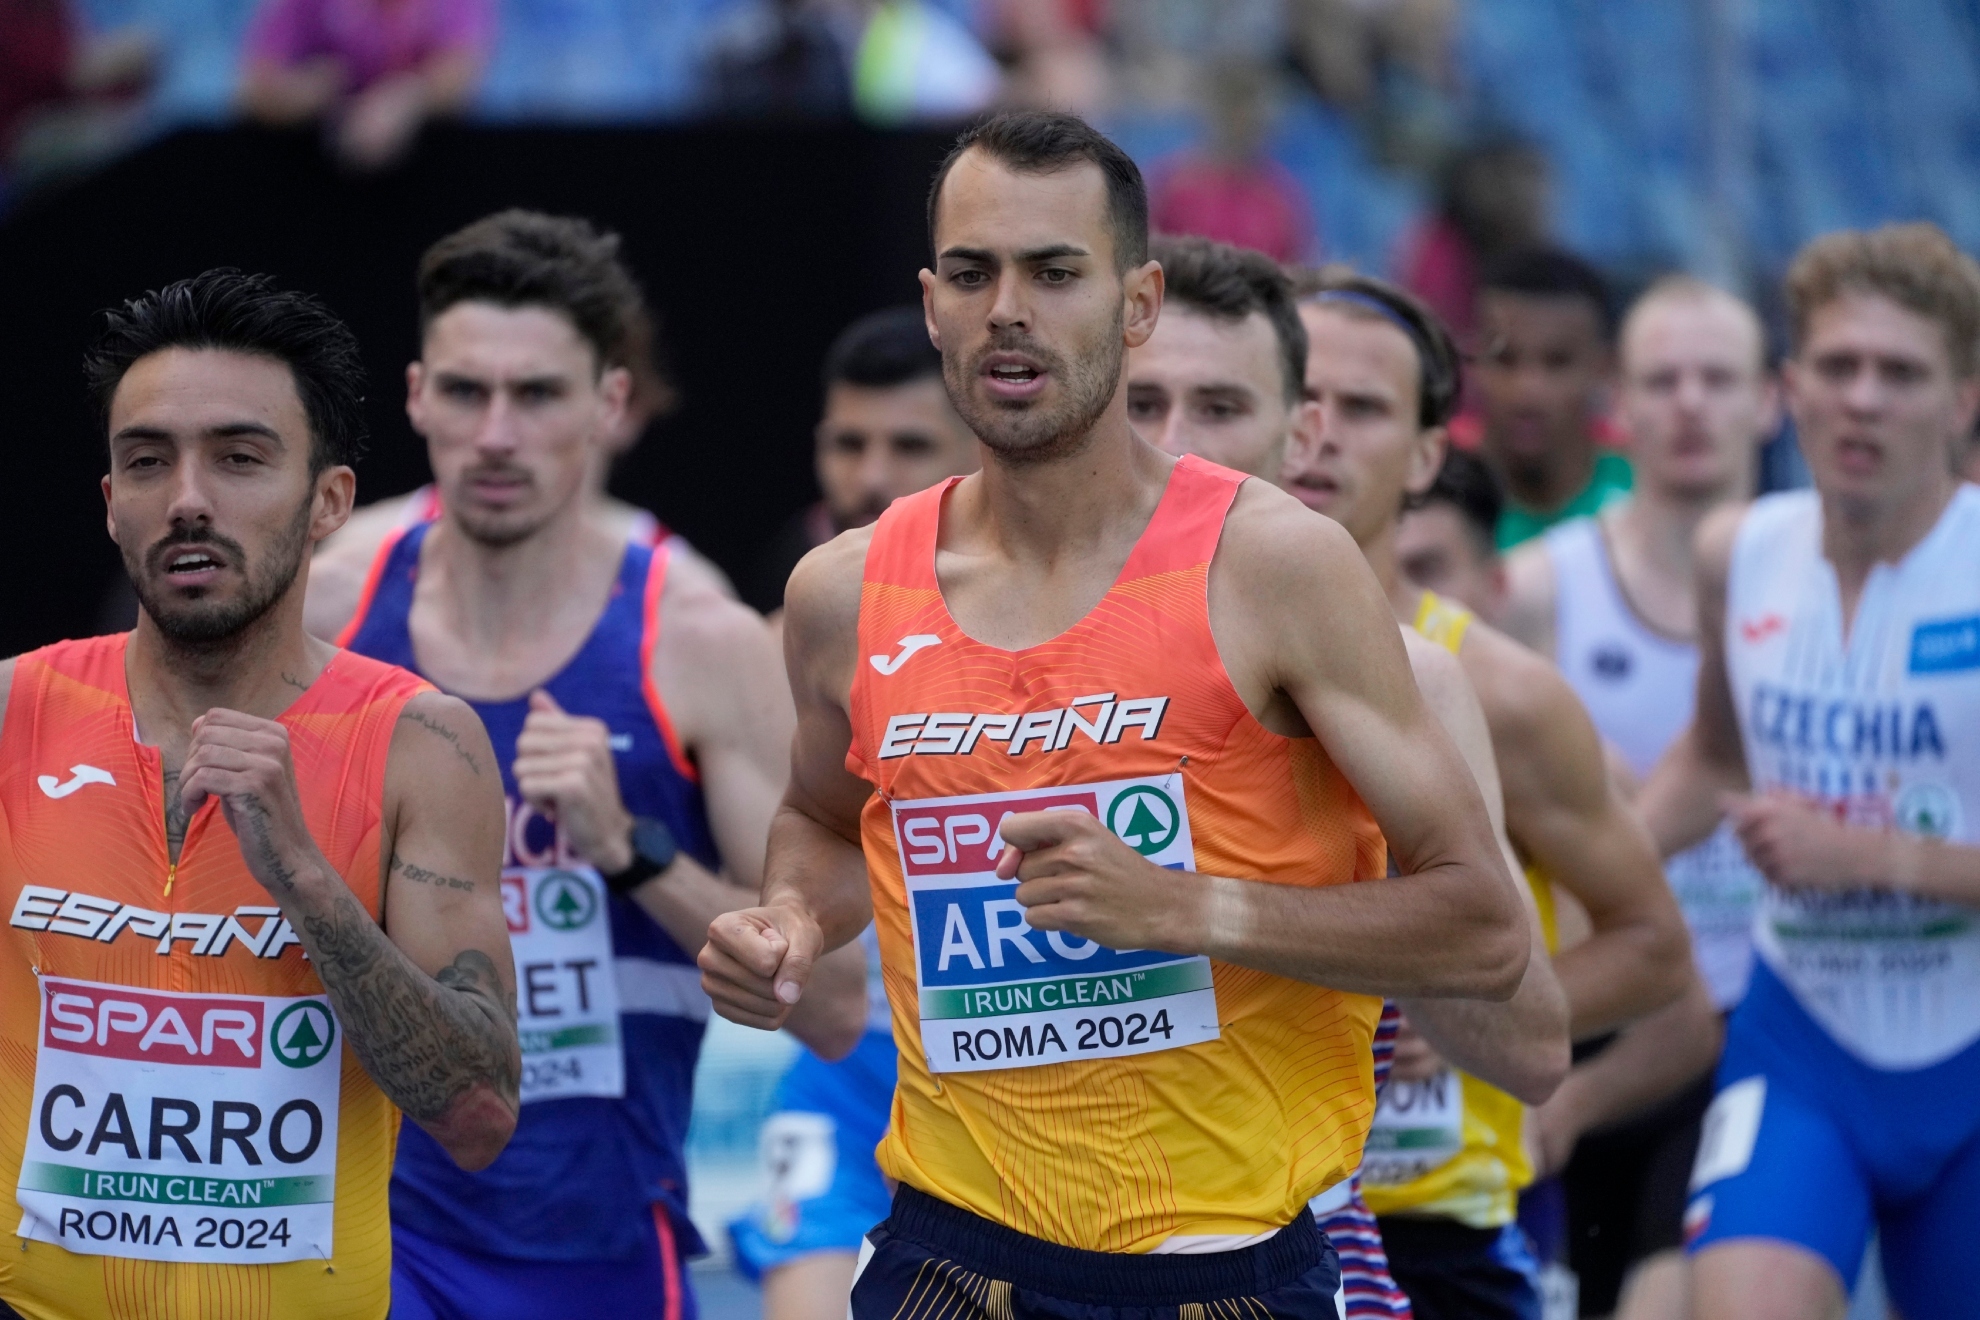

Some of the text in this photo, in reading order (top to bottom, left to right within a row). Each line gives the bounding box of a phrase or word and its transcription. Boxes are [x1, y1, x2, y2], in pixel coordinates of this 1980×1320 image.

[877, 692, 1171, 761] ESPAÑA
[1754, 684, 1945, 758] CZECHIA
[50, 992, 255, 1059] SPAR
[964, 992, 971, 1014] I
[976, 986, 1033, 1013] RUN
[952, 1008, 1175, 1063] ROMA 2024
[39, 1083, 324, 1166] CARRO
[82, 1172, 90, 1195] I
[97, 1174, 159, 1202] RUN
[58, 1206, 292, 1250] ROMA 2024
